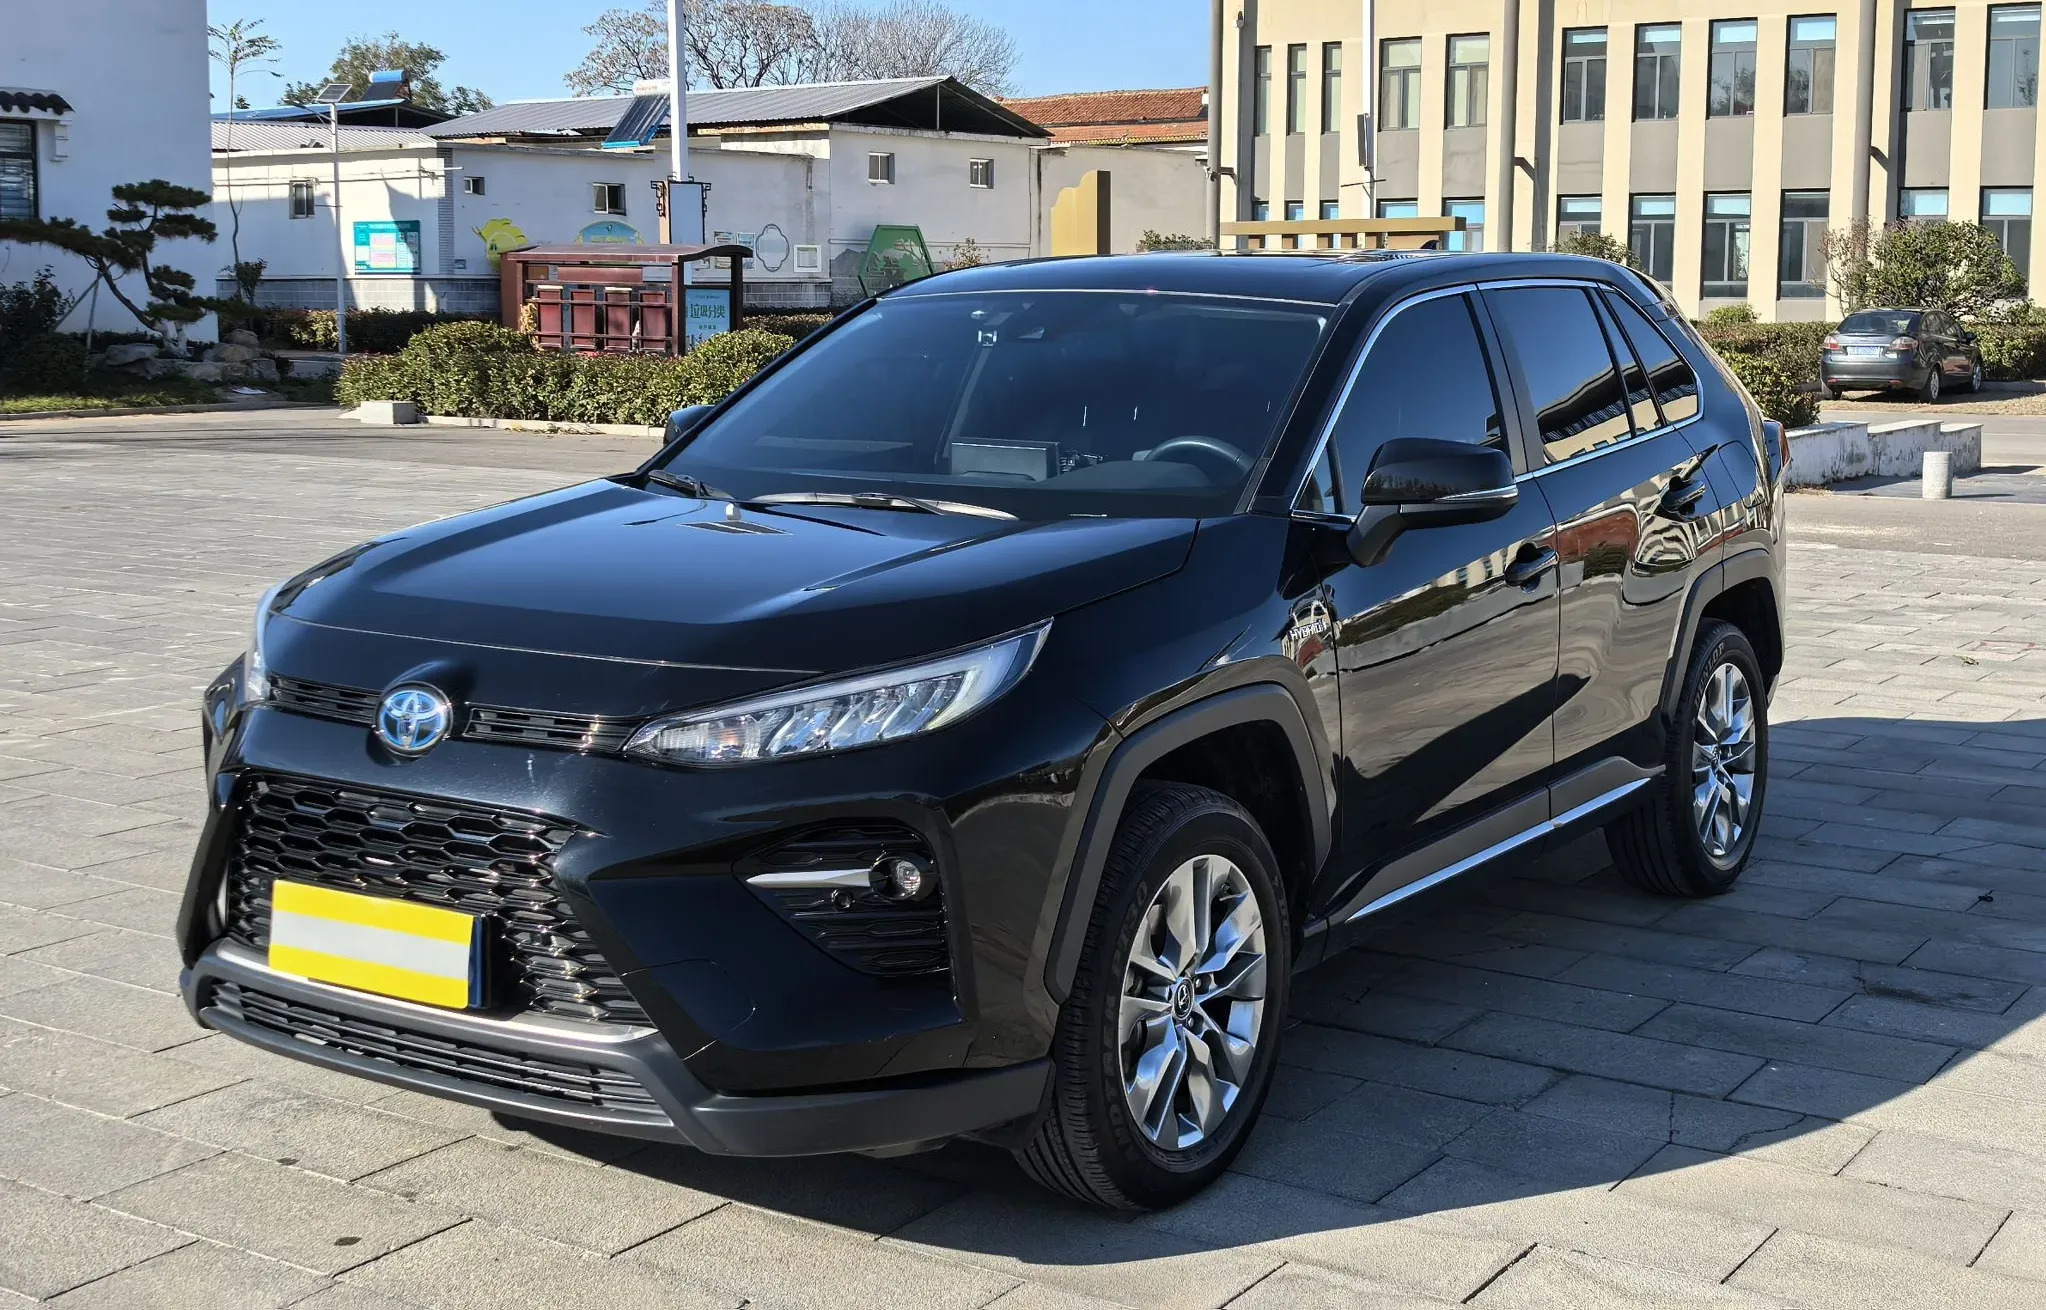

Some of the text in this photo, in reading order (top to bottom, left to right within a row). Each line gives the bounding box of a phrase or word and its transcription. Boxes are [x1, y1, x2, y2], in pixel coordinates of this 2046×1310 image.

[690, 303, 726, 318] 垃圾分类
[1289, 619, 1327, 640] HYBRID
[1694, 642, 1725, 708] DUNLOP
